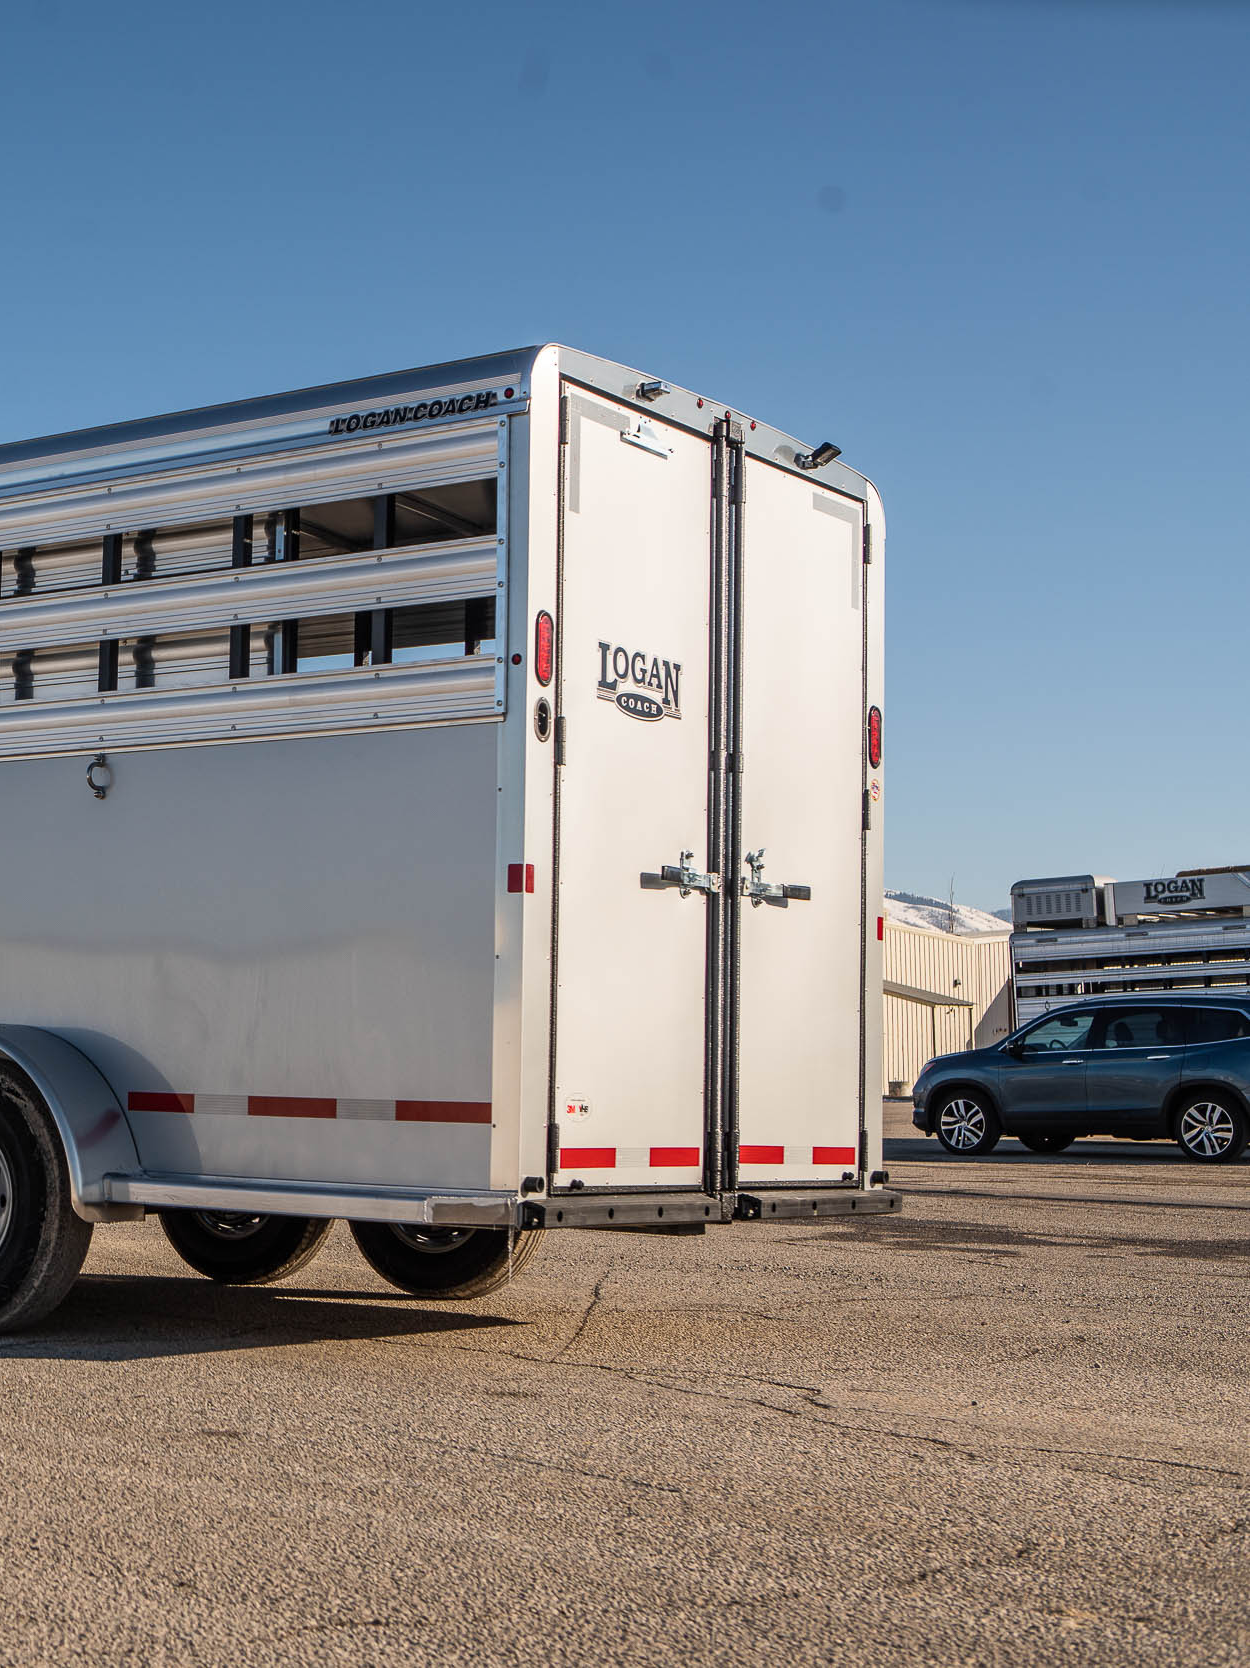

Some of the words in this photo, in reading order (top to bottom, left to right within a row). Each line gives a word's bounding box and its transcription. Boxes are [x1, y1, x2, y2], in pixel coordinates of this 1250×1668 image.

[331, 409, 407, 435] LOGAN
[412, 391, 493, 420] COACH
[598, 641, 681, 709] LOGAN
[621, 696, 658, 715] COACH
[1143, 878, 1205, 900] LOGAN
